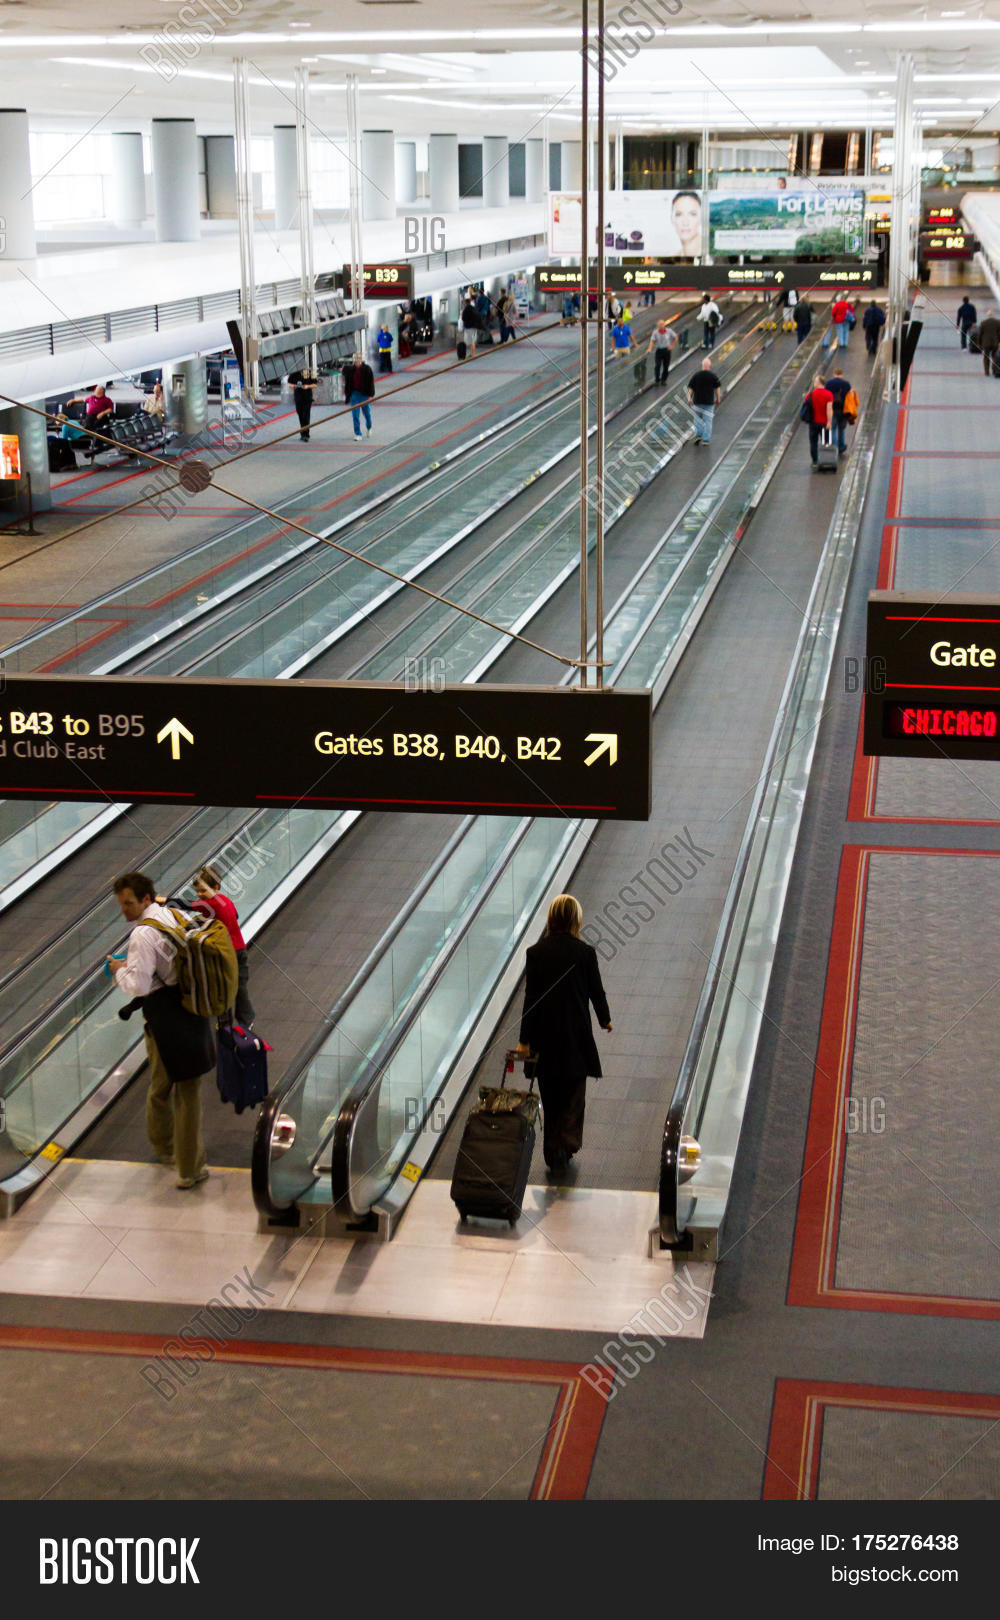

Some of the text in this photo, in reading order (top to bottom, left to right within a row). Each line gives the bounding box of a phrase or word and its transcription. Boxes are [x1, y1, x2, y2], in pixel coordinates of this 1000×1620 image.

[777, 193, 864, 212] Fort Lewis
[375, 268, 399, 283] B39
[929, 640, 997, 668] Gate
[10, 711, 54, 736] B43
[62, 714, 90, 736] to
[98, 714, 146, 737] B95
[902, 708, 997, 737] CHICAGO
[13, 741, 59, 759] Club
[65, 743, 107, 761] East
[314, 731, 562, 762] Gates B38, B40, B42
